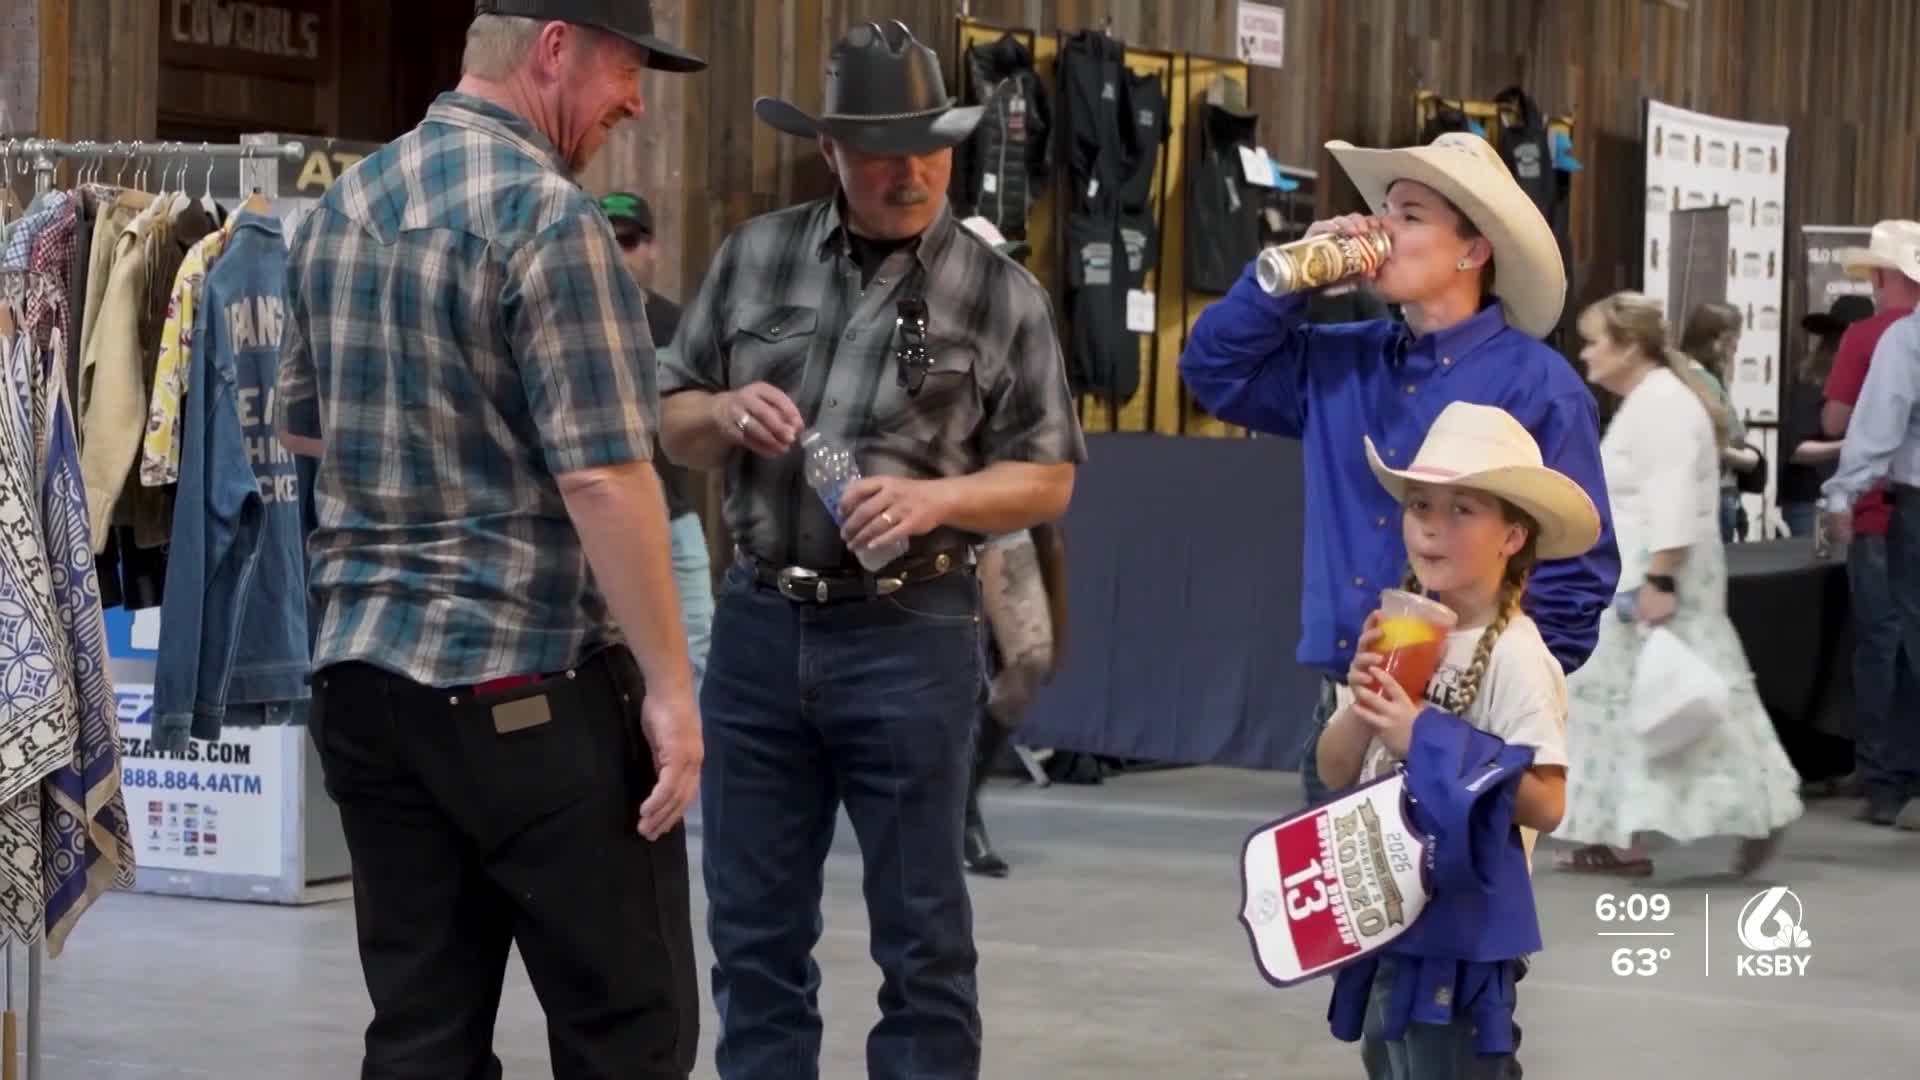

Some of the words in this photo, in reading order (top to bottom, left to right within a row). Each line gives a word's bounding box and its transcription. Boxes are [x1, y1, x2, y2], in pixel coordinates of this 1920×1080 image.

[171, 0, 319, 58] COWGIRLS
[1334, 810, 1386, 938] RODEO
[1386, 832, 1413, 874] 2026
[1283, 857, 1329, 921] 13
